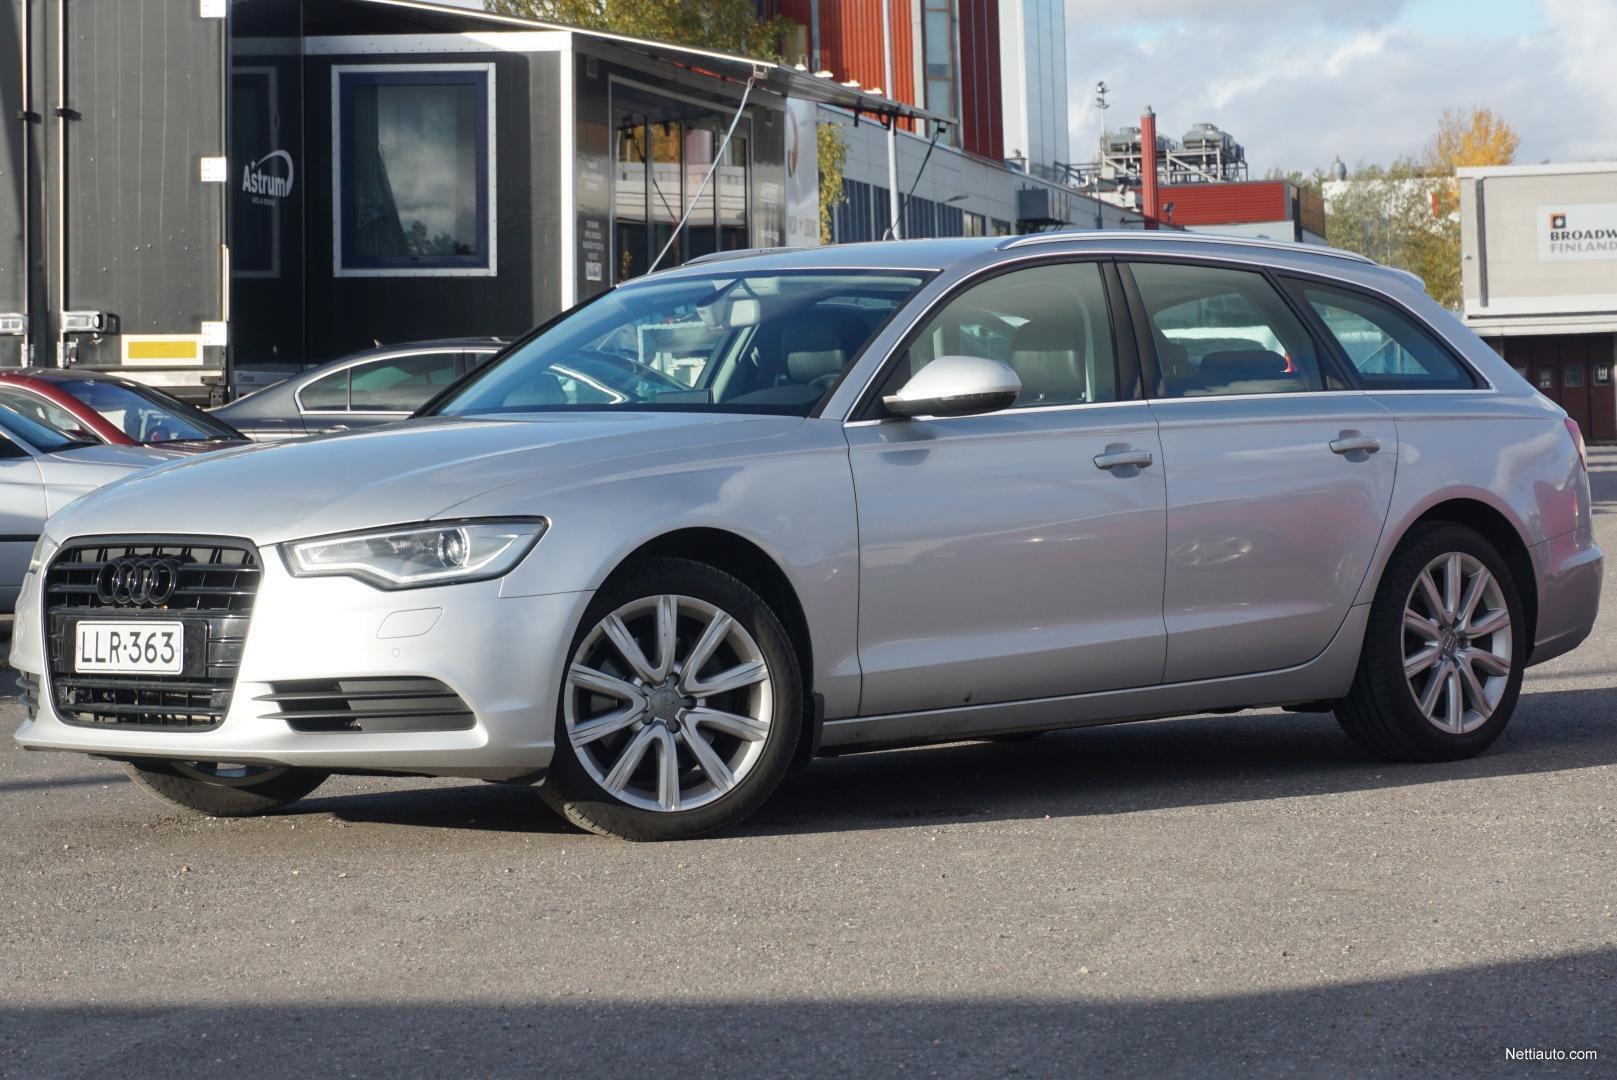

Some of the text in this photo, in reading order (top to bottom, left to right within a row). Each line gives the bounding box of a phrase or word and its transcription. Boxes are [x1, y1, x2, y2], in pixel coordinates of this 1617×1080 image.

[242, 165, 286, 197] Astrum
[1550, 229, 1617, 241] BROADW
[1551, 240, 1617, 253] FINLAND
